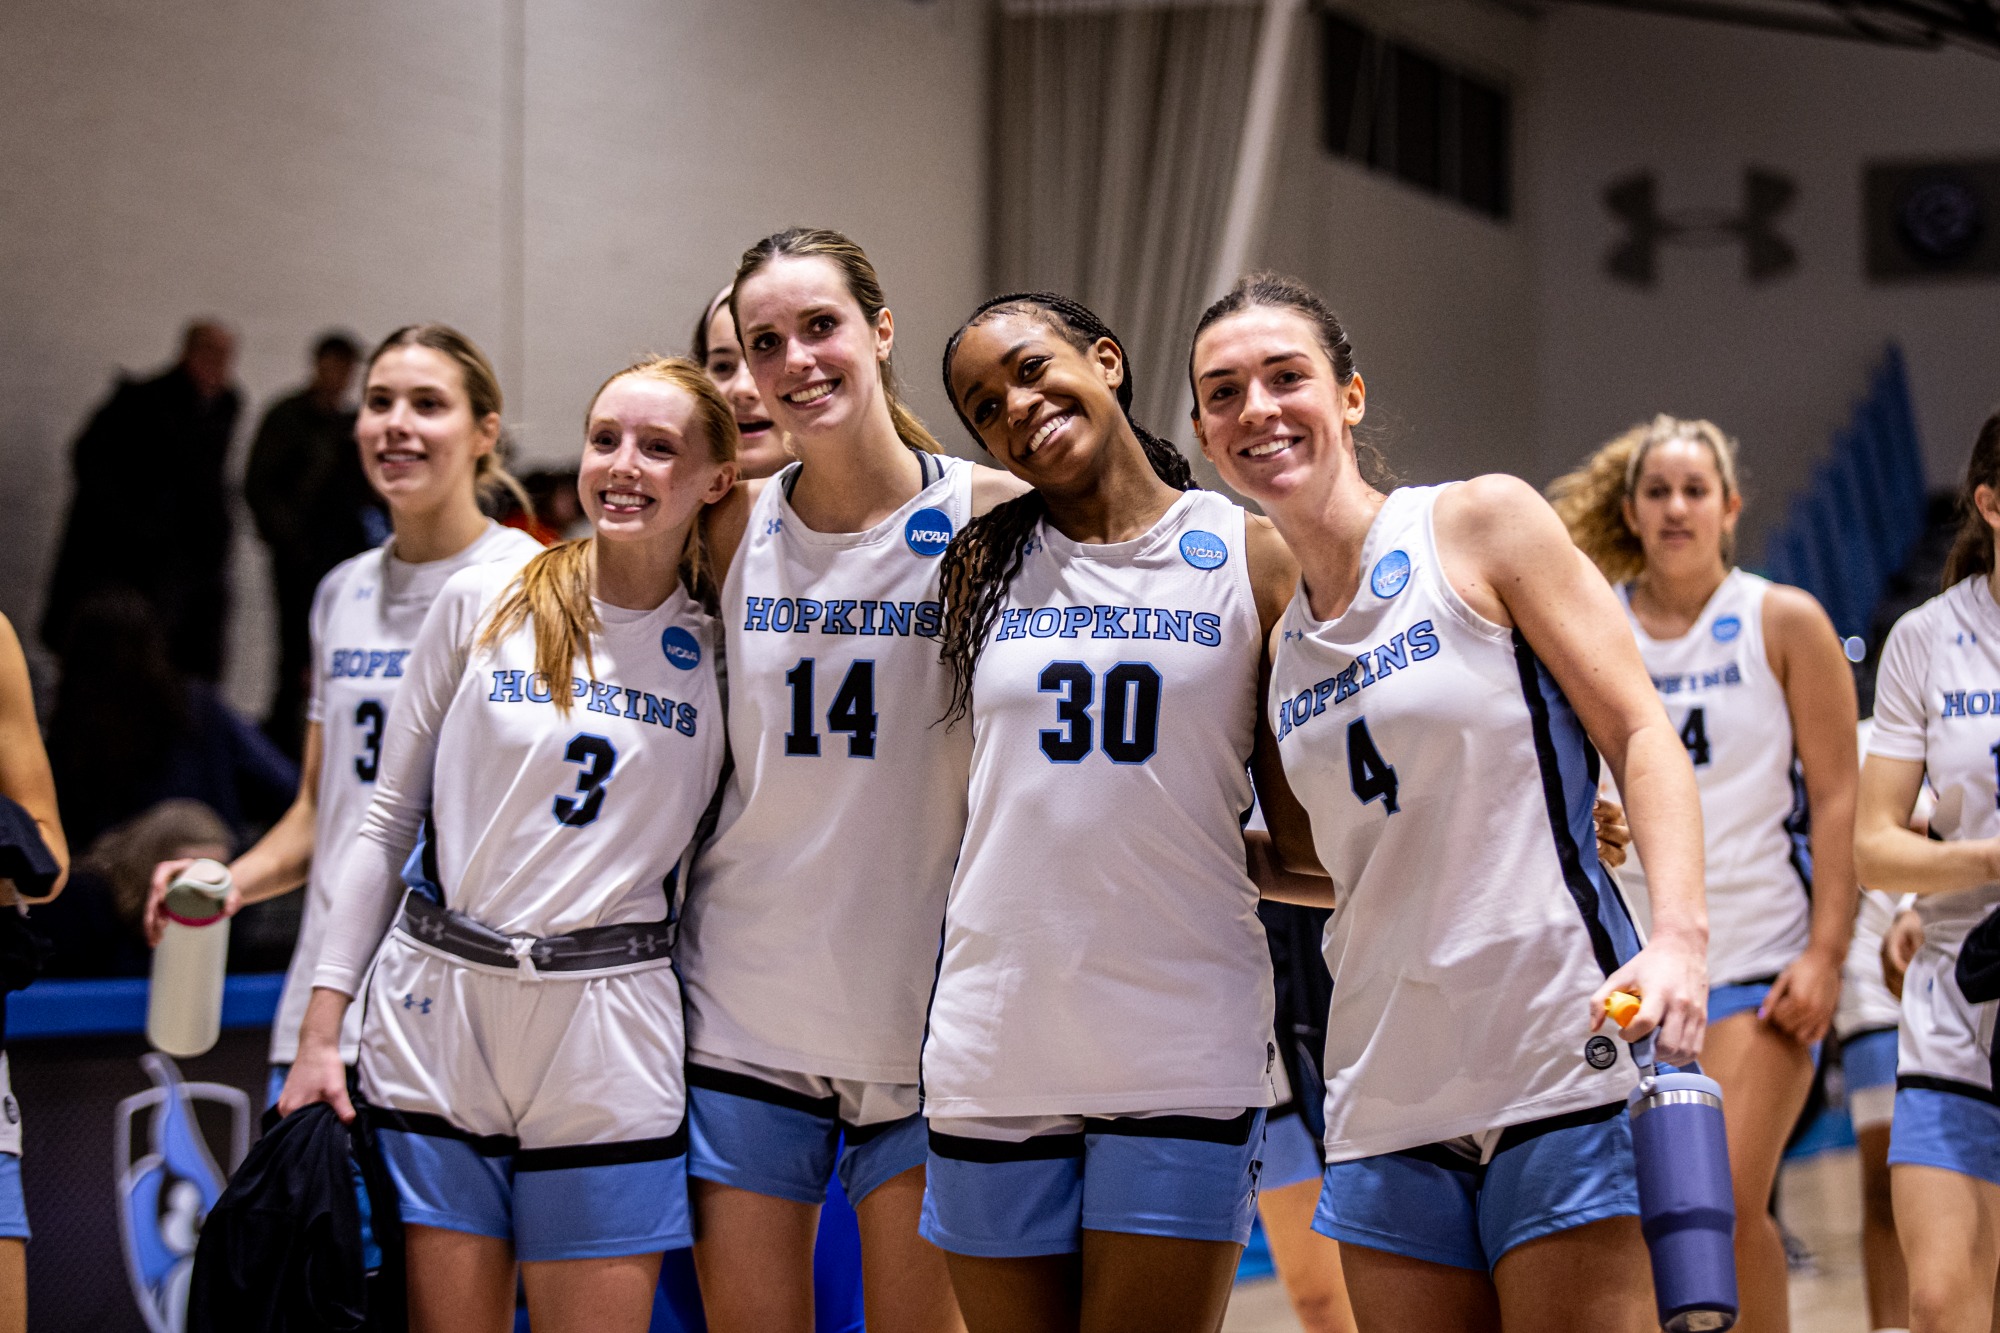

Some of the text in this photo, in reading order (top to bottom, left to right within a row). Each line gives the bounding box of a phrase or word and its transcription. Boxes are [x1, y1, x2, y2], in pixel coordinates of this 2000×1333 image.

[911, 530, 950, 544] NCAA
[1185, 546, 1223, 559] NCAA
[666, 644, 698, 661] NCAA
[744, 596, 942, 638] HOPKINS
[995, 605, 1222, 647] HOPKINS
[785, 657, 879, 760] 14
[1037, 660, 1163, 765] 30
[1278, 620, 1441, 742] HOPKINS
[354, 699, 384, 784] 3
[1346, 716, 1401, 816] 4
[1680, 706, 1711, 766] 4
[552, 732, 618, 828] 3
